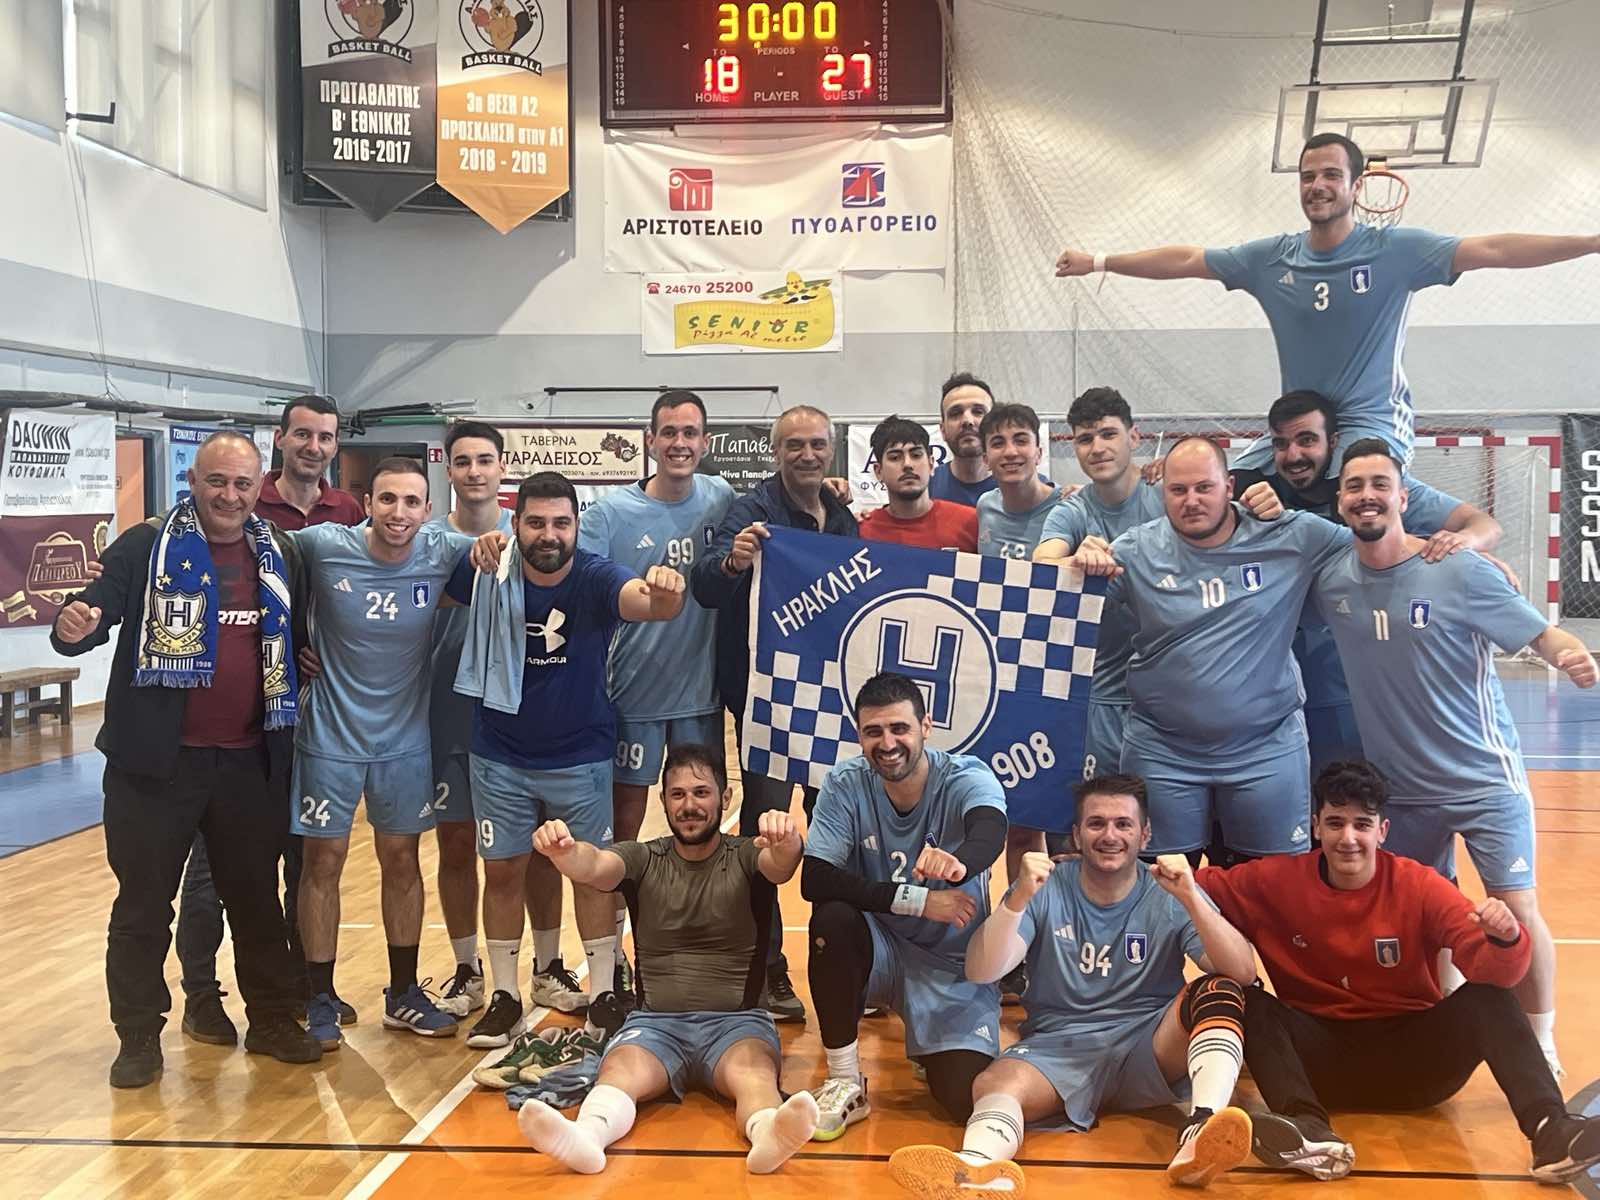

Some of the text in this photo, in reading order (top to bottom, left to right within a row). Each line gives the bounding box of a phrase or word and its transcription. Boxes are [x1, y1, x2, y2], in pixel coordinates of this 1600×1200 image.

[718, 2, 837, 42] 30:00
[331, 42, 411, 61] BASKET BALL
[465, 54, 541, 73] BASKET BALL
[704, 56, 740, 93] 18
[822, 53, 873, 92] 27
[320, 79, 421, 108] ΠΡΩΤΑΘΛΗΤΗΣ
[487, 92, 517, 116] ΘΕΣΗ
[695, 91, 730, 103] HOME
[753, 91, 800, 102] PLAYER
[823, 89, 863, 101] GUEST
[351, 109, 412, 136] ΕΘΝΙΚΗΣ
[441, 119, 564, 147] ΠΡΟΣΚΛΗΣΗ στην Α1
[332, 137, 411, 164] 2016-2017
[459, 147, 496, 172] 2018
[511, 149, 547, 175] 2019
[623, 219, 763, 236] ΑΡΙΣΤΟΤΕΛΕΙΟ
[792, 215, 937, 234] ΠΥΘΑΓΟΡΕΙΟ
[665, 281, 753, 294] 24670 25200
[1313, 281, 1329, 312] 3
[688, 314, 809, 334] SENIOR
[12, 420, 71, 450] DAUWIN
[521, 436, 577, 446] ΤΑΒΕΡΝΑ
[8, 465, 65, 478] ΚΟΥΦΩΜΑΤΑ
[860, 481, 888, 491] ΦΥΣ
[667, 537, 695, 567] 99
[365, 591, 399, 621] 24
[771, 547, 882, 637] ΗΡΑΚΛΗΣ
[1198, 578, 1225, 608] 10
[217, 610, 260, 625] RTER
[1373, 609, 1390, 641] 11
[527, 656, 567, 665] ARMOUR
[615, 740, 645, 770] 99
[991, 731, 1056, 788] 908
[299, 796, 331, 828] 24
[890, 851, 907, 883] 2
[1079, 942, 1112, 977] 94
